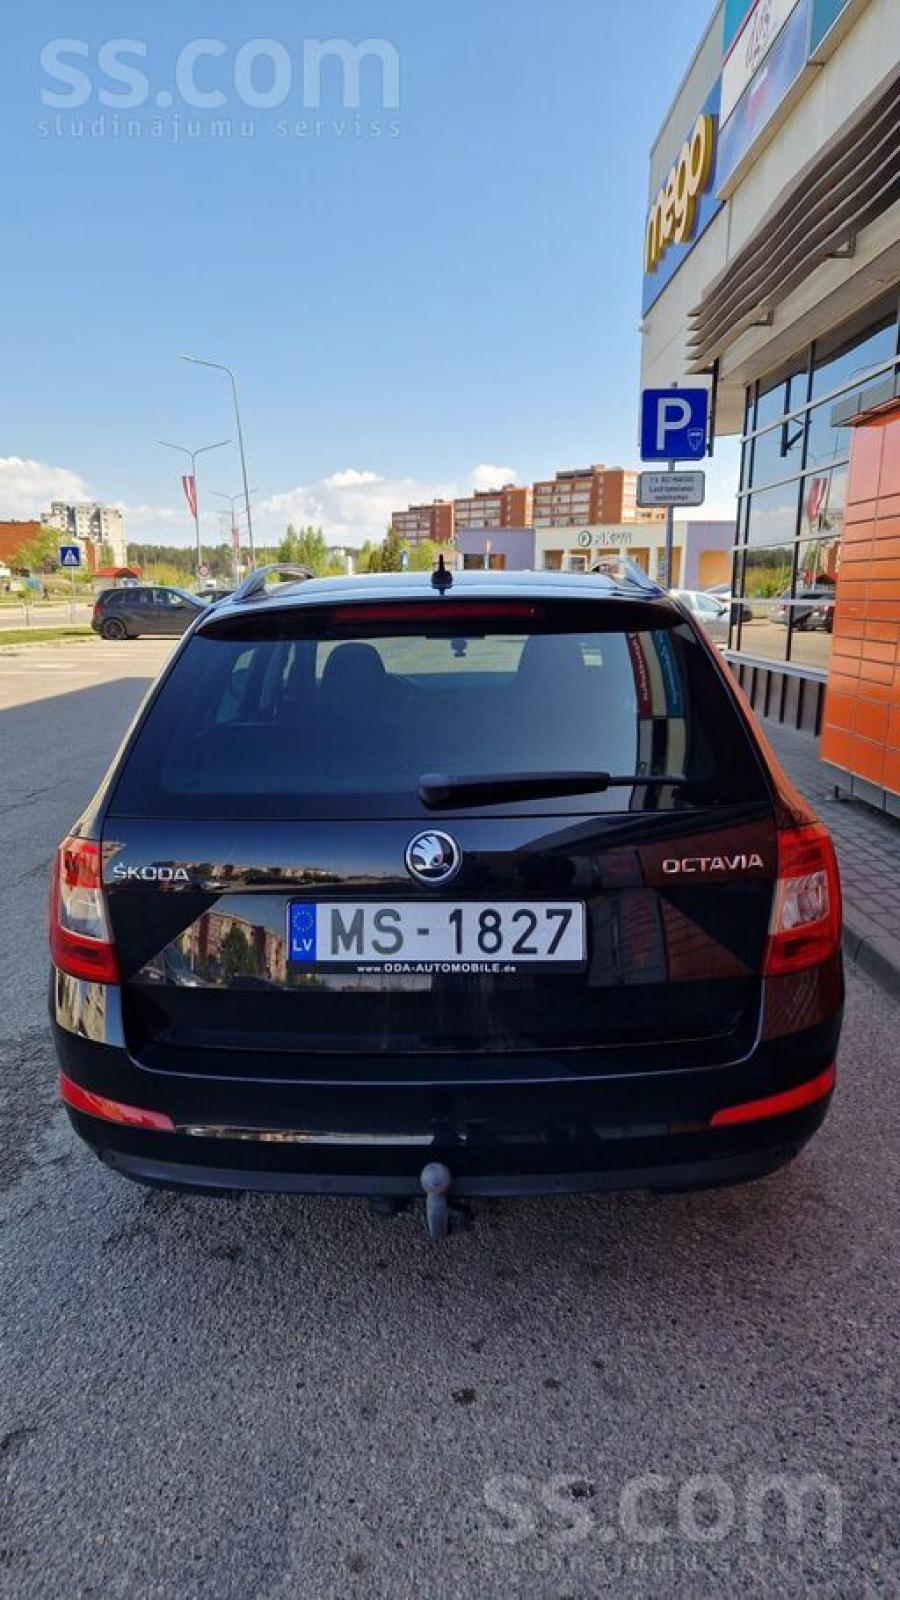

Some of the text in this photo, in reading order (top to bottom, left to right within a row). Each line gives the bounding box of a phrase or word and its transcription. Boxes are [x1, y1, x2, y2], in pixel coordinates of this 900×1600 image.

[645, 113, 713, 273] mego
[656, 398, 692, 451] P
[113, 862, 190, 882] ŠKODA
[662, 853, 764, 873] OCTAVIA
[330, 908, 573, 955] MS-1827
[293, 939, 313, 951] LV
[357, 963, 517, 974] www.ODA-AUTOMOBILE.de
